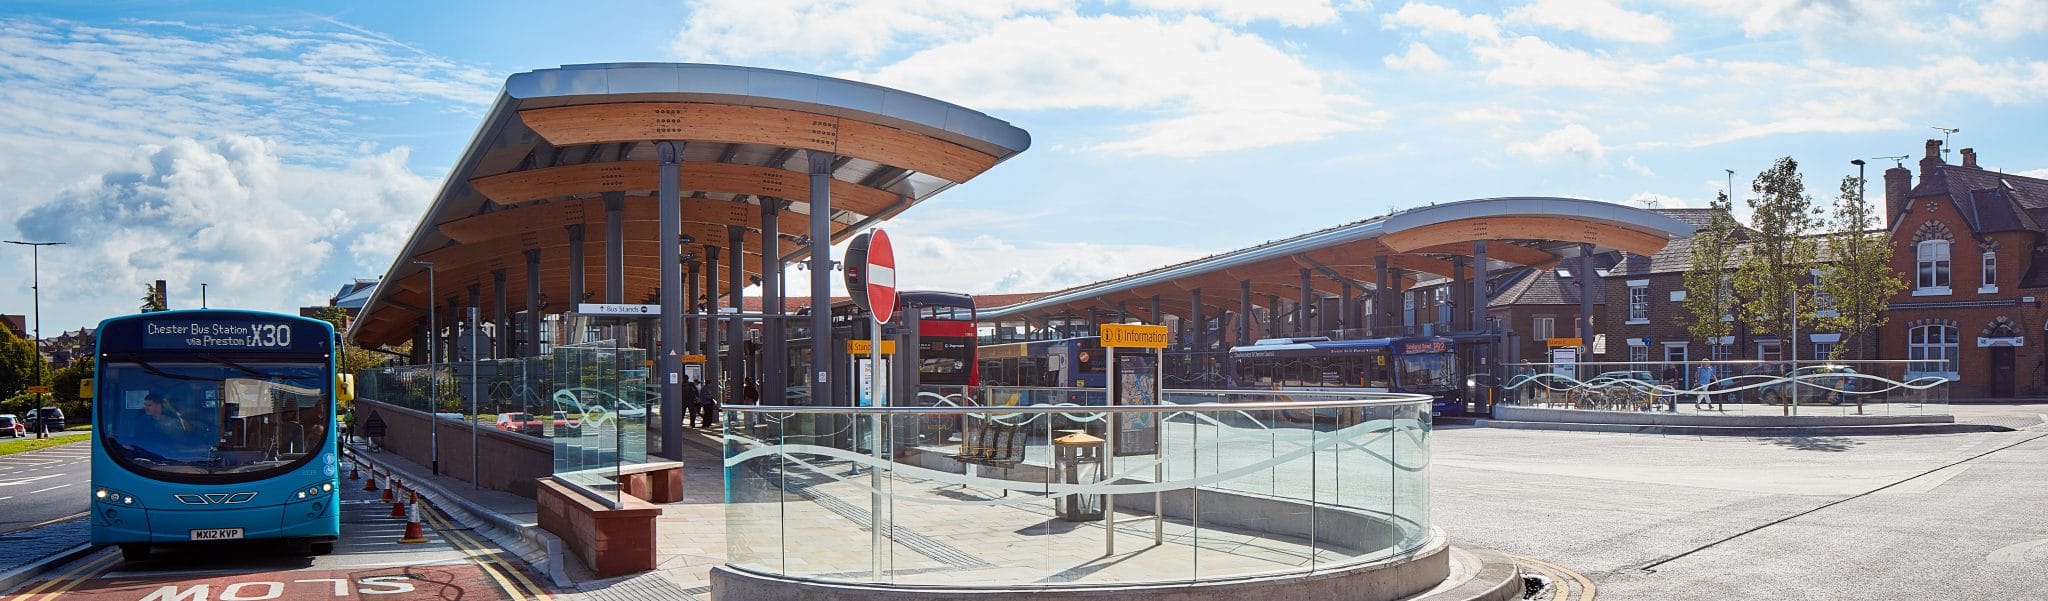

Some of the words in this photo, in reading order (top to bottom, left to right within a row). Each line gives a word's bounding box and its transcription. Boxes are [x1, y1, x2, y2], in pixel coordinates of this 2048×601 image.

[148, 323, 188, 335] Chester
[191, 323, 210, 335] Bus
[212, 323, 248, 335] Station
[251, 324, 291, 347] X30
[186, 337, 201, 346] via
[204, 335, 246, 347] Preston
[1125, 329, 1167, 343] Information
[196, 530, 217, 539] MX12
[219, 529, 238, 538] KVP
[139, 576, 416, 601] SLOW
